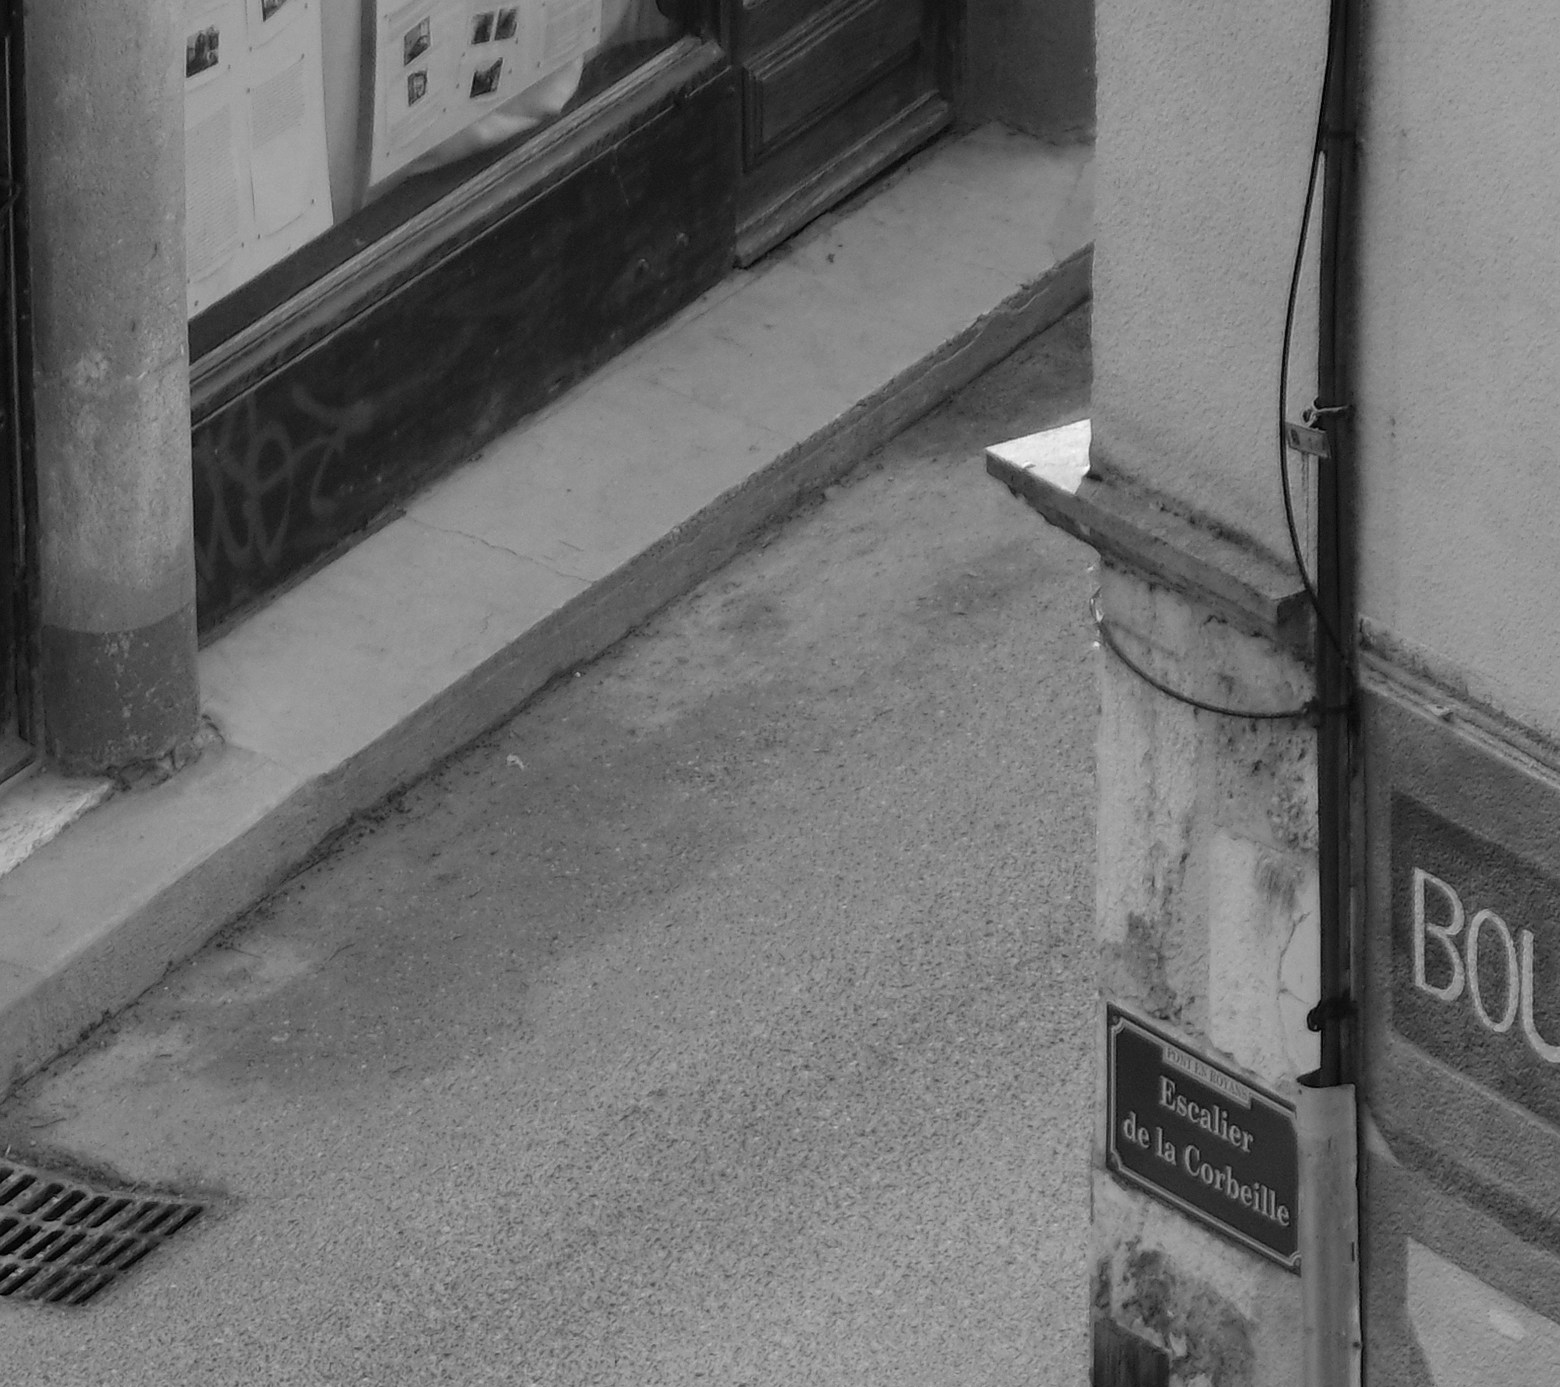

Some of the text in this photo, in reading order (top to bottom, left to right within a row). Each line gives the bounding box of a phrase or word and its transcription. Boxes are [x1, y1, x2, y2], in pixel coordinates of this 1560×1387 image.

[1159, 1074, 1254, 1153] Escalier
[1122, 1111, 1290, 1227] de la Corbeille
